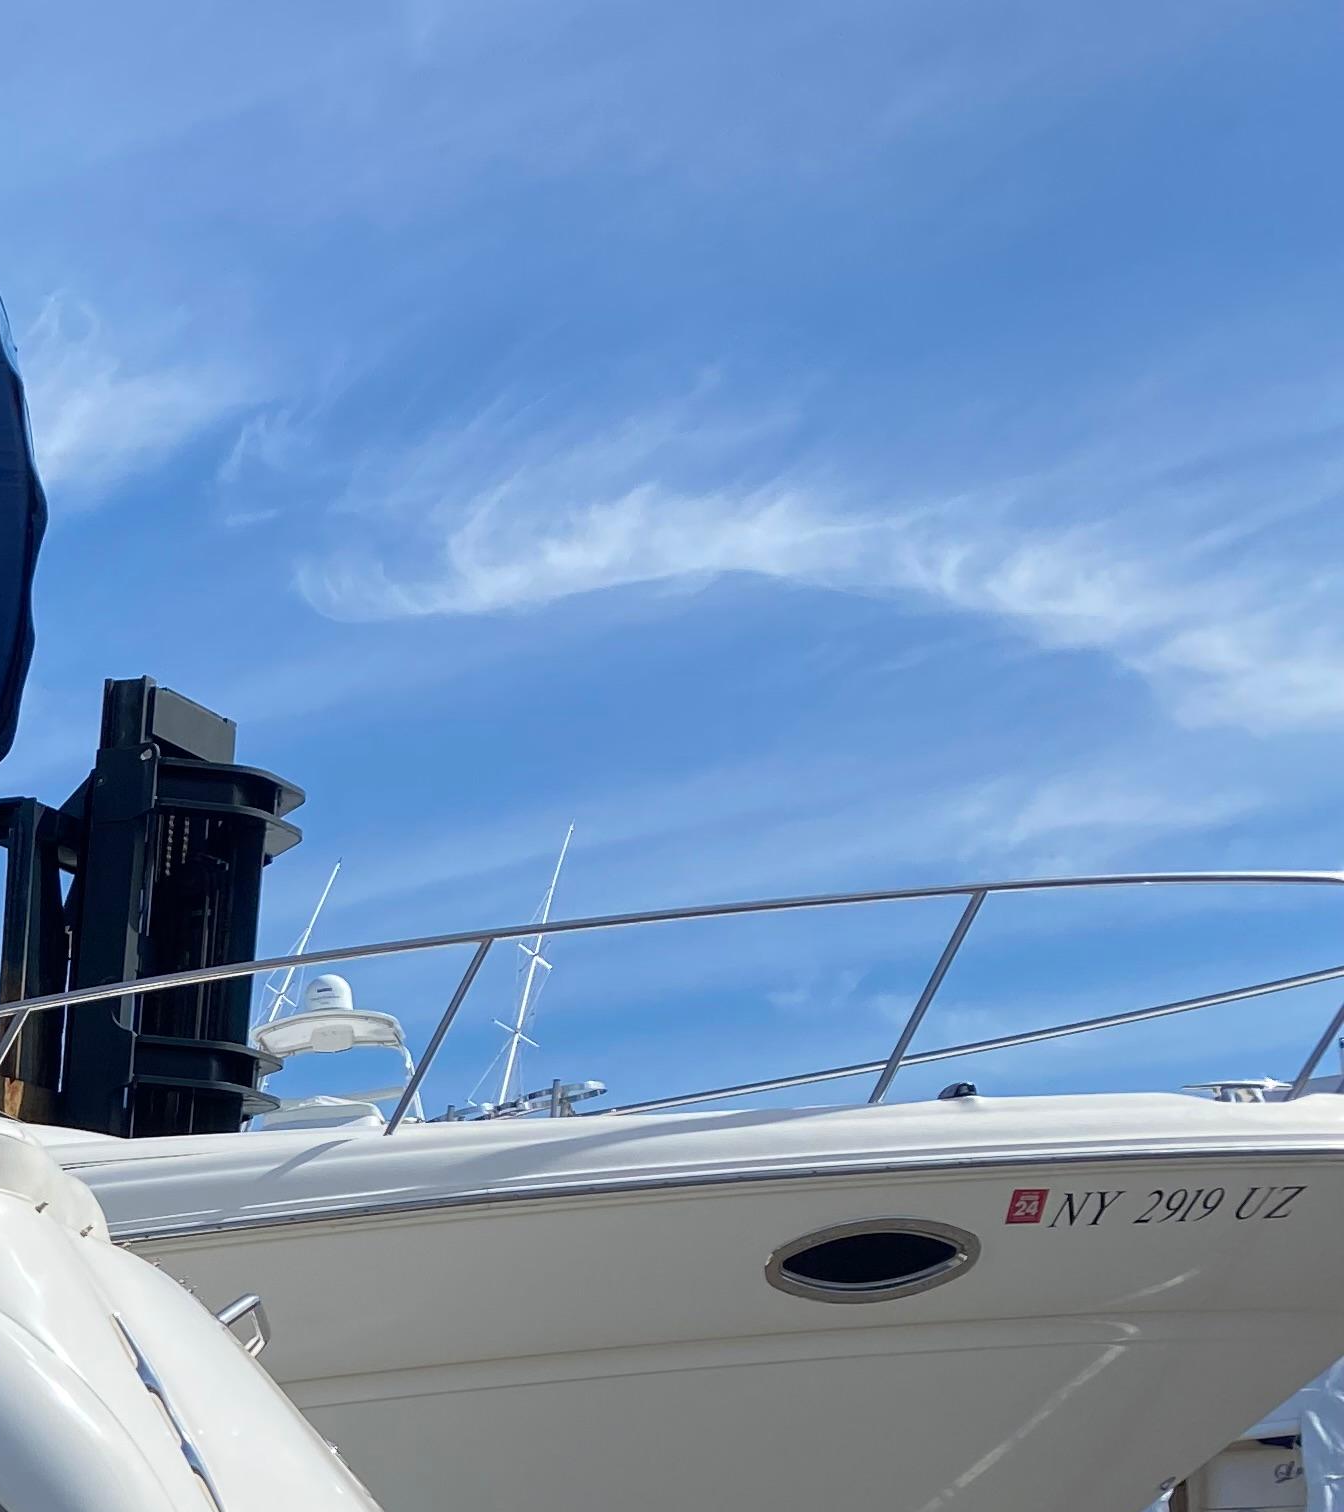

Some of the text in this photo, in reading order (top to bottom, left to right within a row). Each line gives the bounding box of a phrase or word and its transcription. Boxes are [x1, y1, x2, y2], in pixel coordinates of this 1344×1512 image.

[1014, 1200, 1039, 1216] 24
[1047, 1185, 1308, 1228] NY 2919 UZ
